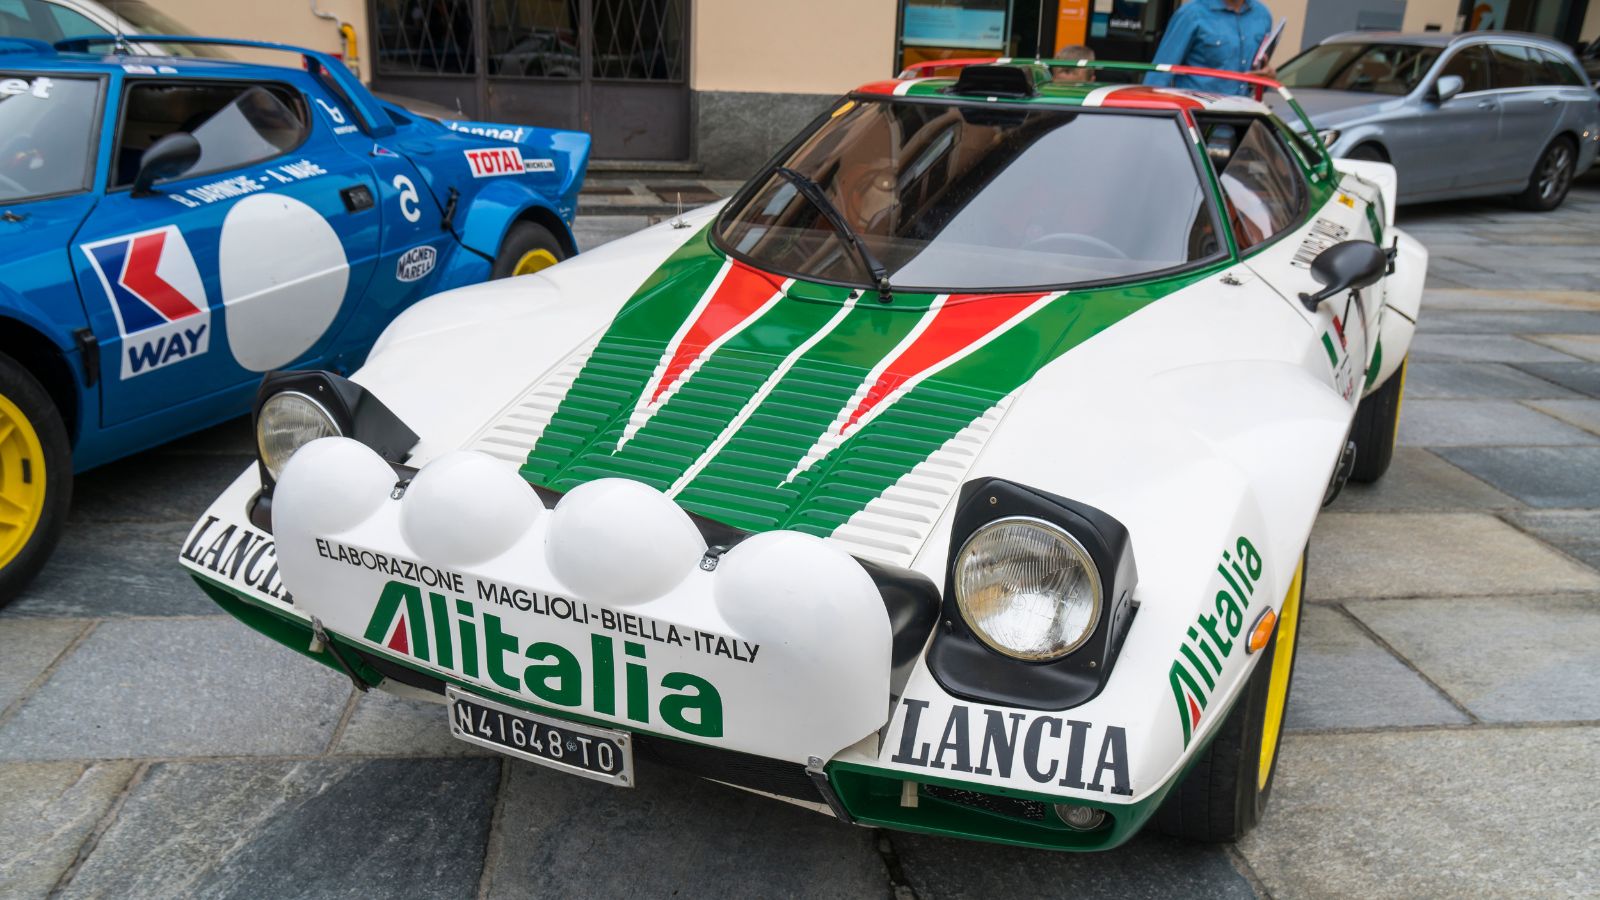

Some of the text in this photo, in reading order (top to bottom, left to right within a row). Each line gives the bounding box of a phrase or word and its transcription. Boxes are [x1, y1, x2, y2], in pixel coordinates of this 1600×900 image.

[468, 150, 523, 174] TOTAL
[525, 161, 553, 169] MICHELIN
[128, 323, 207, 373] WAY
[181, 515, 294, 605] LANCI
[316, 538, 465, 593] ELABORAZIONE
[364, 580, 723, 738] Alitalia
[1169, 536, 1262, 753] Alitalia
[457, 703, 614, 772] N41648 TO
[891, 698, 1134, 797] LANCIA
